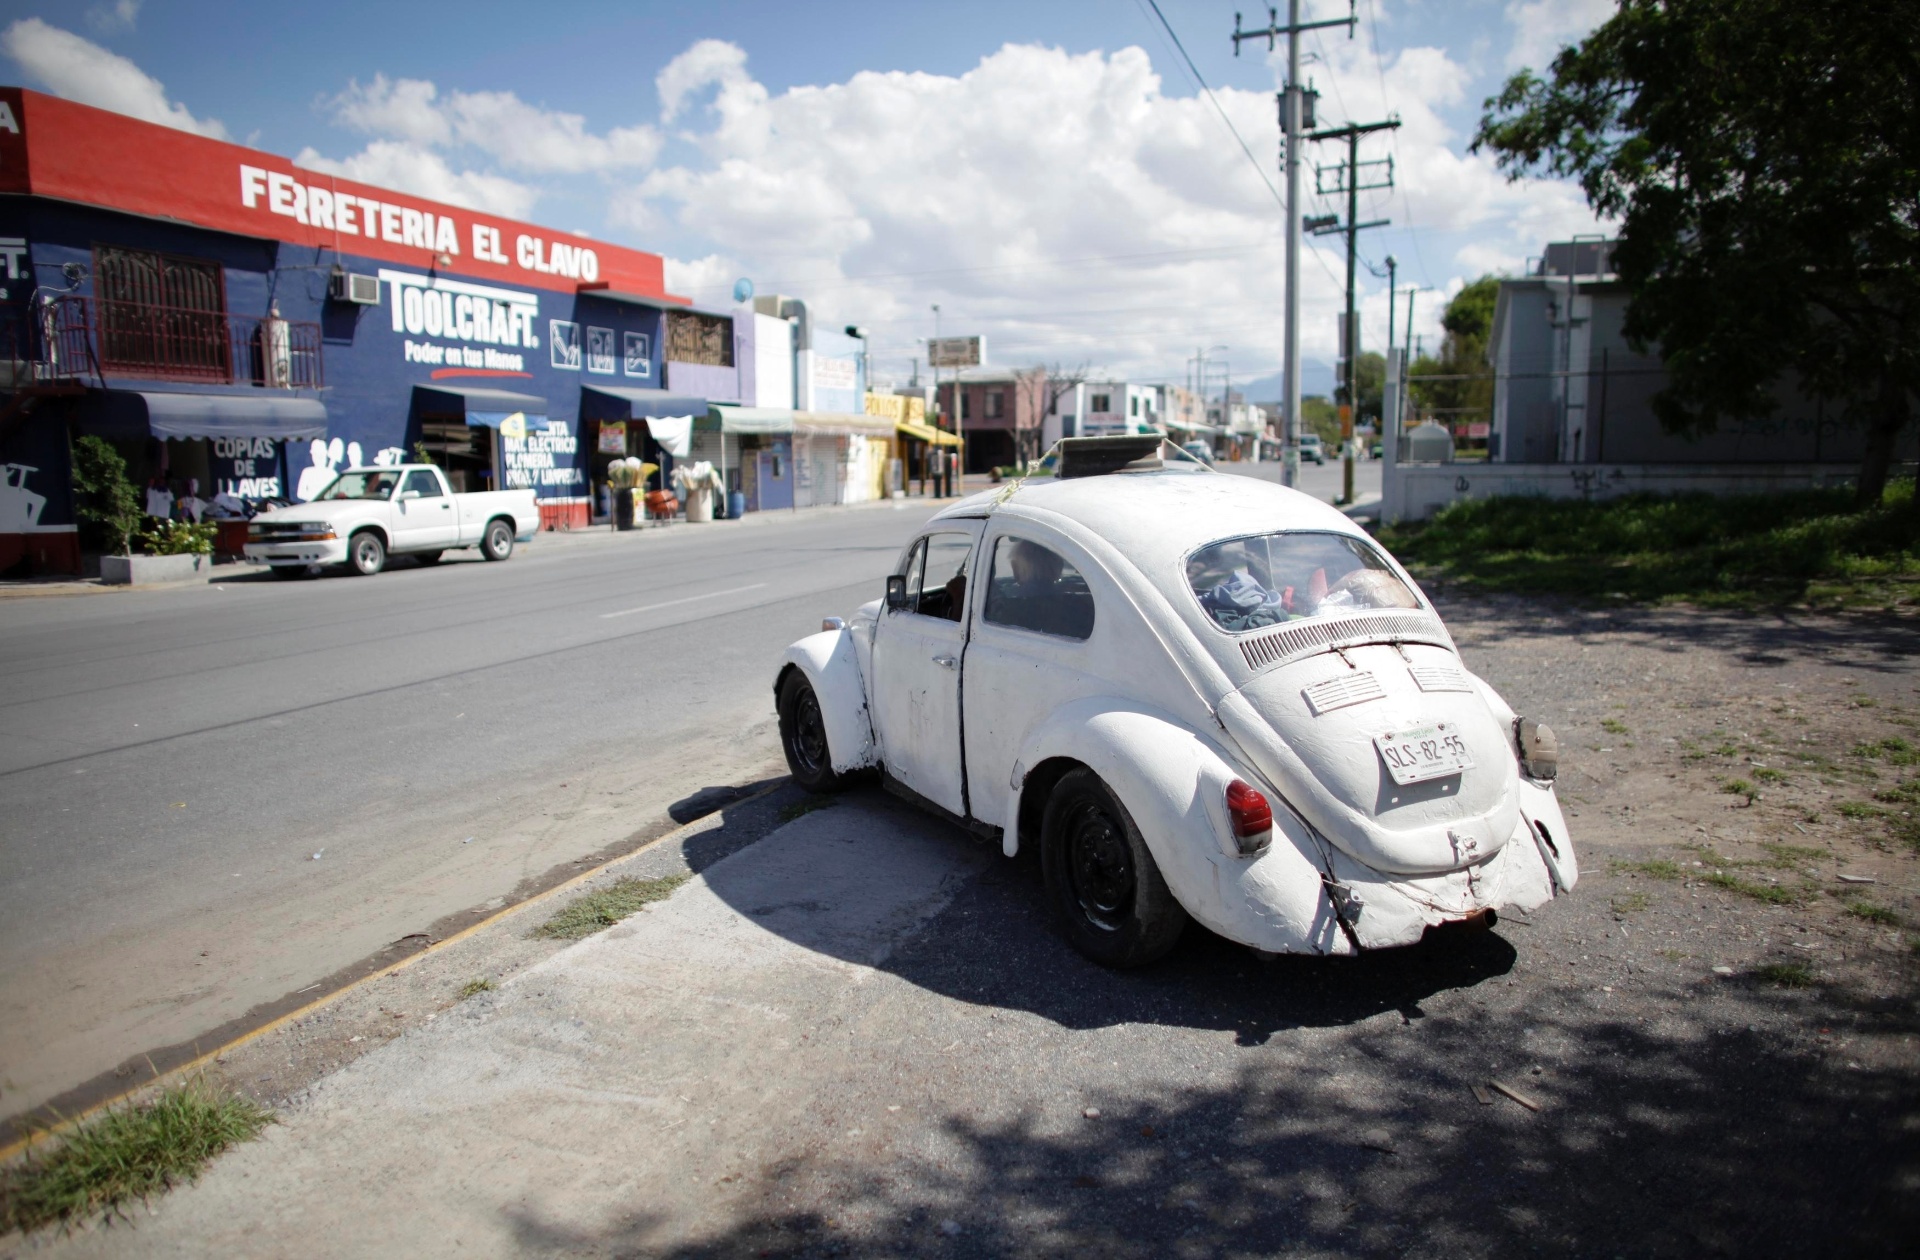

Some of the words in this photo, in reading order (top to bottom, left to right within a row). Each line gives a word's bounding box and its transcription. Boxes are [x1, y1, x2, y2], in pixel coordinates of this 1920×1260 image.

[240, 164, 460, 255] FERRETERIA
[472, 223, 509, 265] EL
[516, 234, 598, 283] CLAVO
[378, 268, 540, 349] TOOLCRAFT
[404, 339, 444, 365] Poder
[445, 347, 462, 366] en
[462, 345, 484, 369] tus
[484, 347, 524, 372] Manos
[214, 436, 275, 459] COPIAS
[528, 437, 576, 453] ELECTRICO
[233, 459, 256, 477] DE
[505, 453, 554, 469] PLOMERIA
[1385, 735, 1465, 768] SLS-82-55
